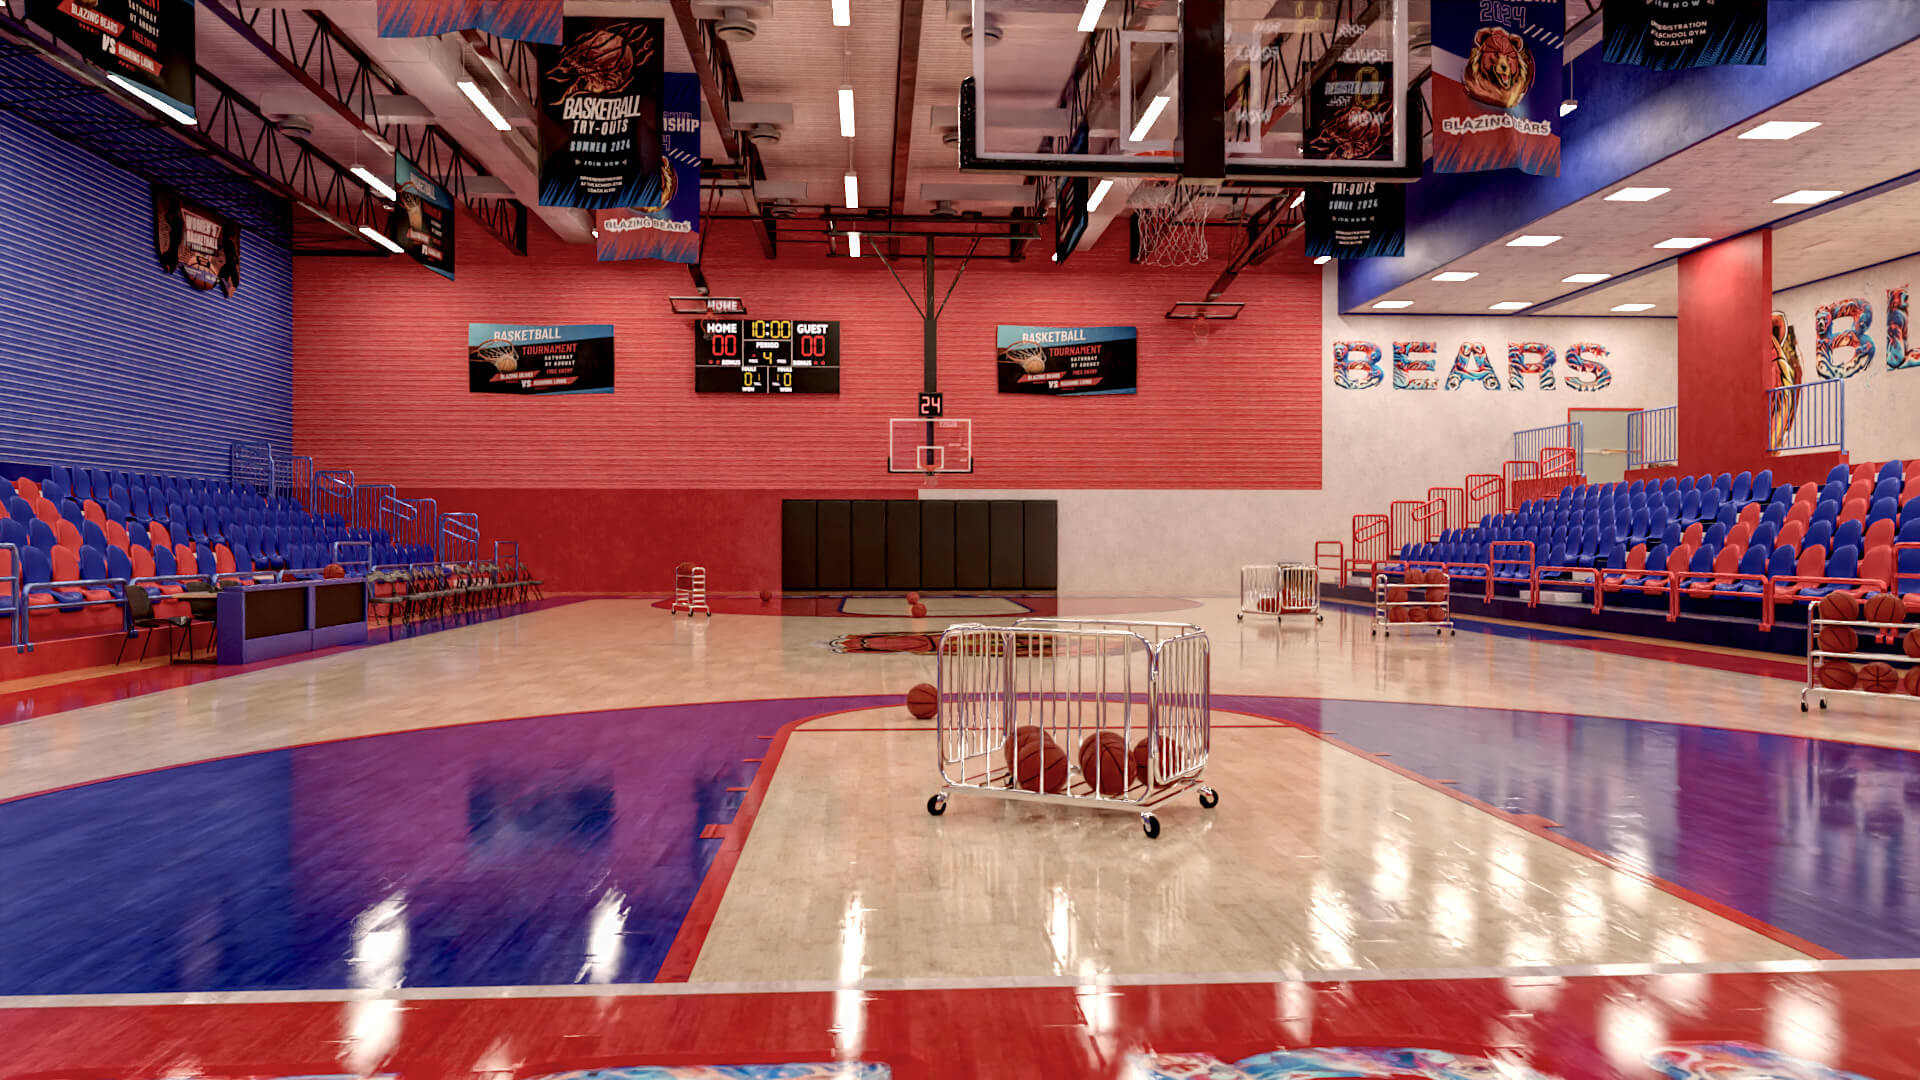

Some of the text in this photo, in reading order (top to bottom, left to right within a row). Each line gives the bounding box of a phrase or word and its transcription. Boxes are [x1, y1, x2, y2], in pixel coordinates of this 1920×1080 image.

[1673, 0, 1700, 8] NOW
[71, 2, 99, 24] BLAZING
[1688, 28, 1707, 36] GYM
[102, 33, 116, 55] VS
[1670, 38, 1693, 46] ALVIN
[562, 95, 641, 120] BASKETBALL
[573, 119, 629, 135] TRY-OUTS
[1443, 113, 1513, 135] BLAZING
[604, 217, 691, 232] BLAZING BEARS
[494, 328, 562, 342] BASKETBALL
[707, 323, 737, 333] HOME
[752, 320, 790, 338] 10:00
[797, 324, 828, 334] GUEST
[1022, 329, 1086, 345] BASKETBALL
[522, 343, 578, 356] TOURNAMENT
[712, 335, 736, 356] 00
[801, 335, 825, 357] 00
[1048, 345, 1102, 358] TOURNAMENT
[762, 352, 772, 364] 4
[1333, 341, 1612, 392] BEARS
[521, 379, 531, 388] VS
[921, 396, 941, 414] 24
